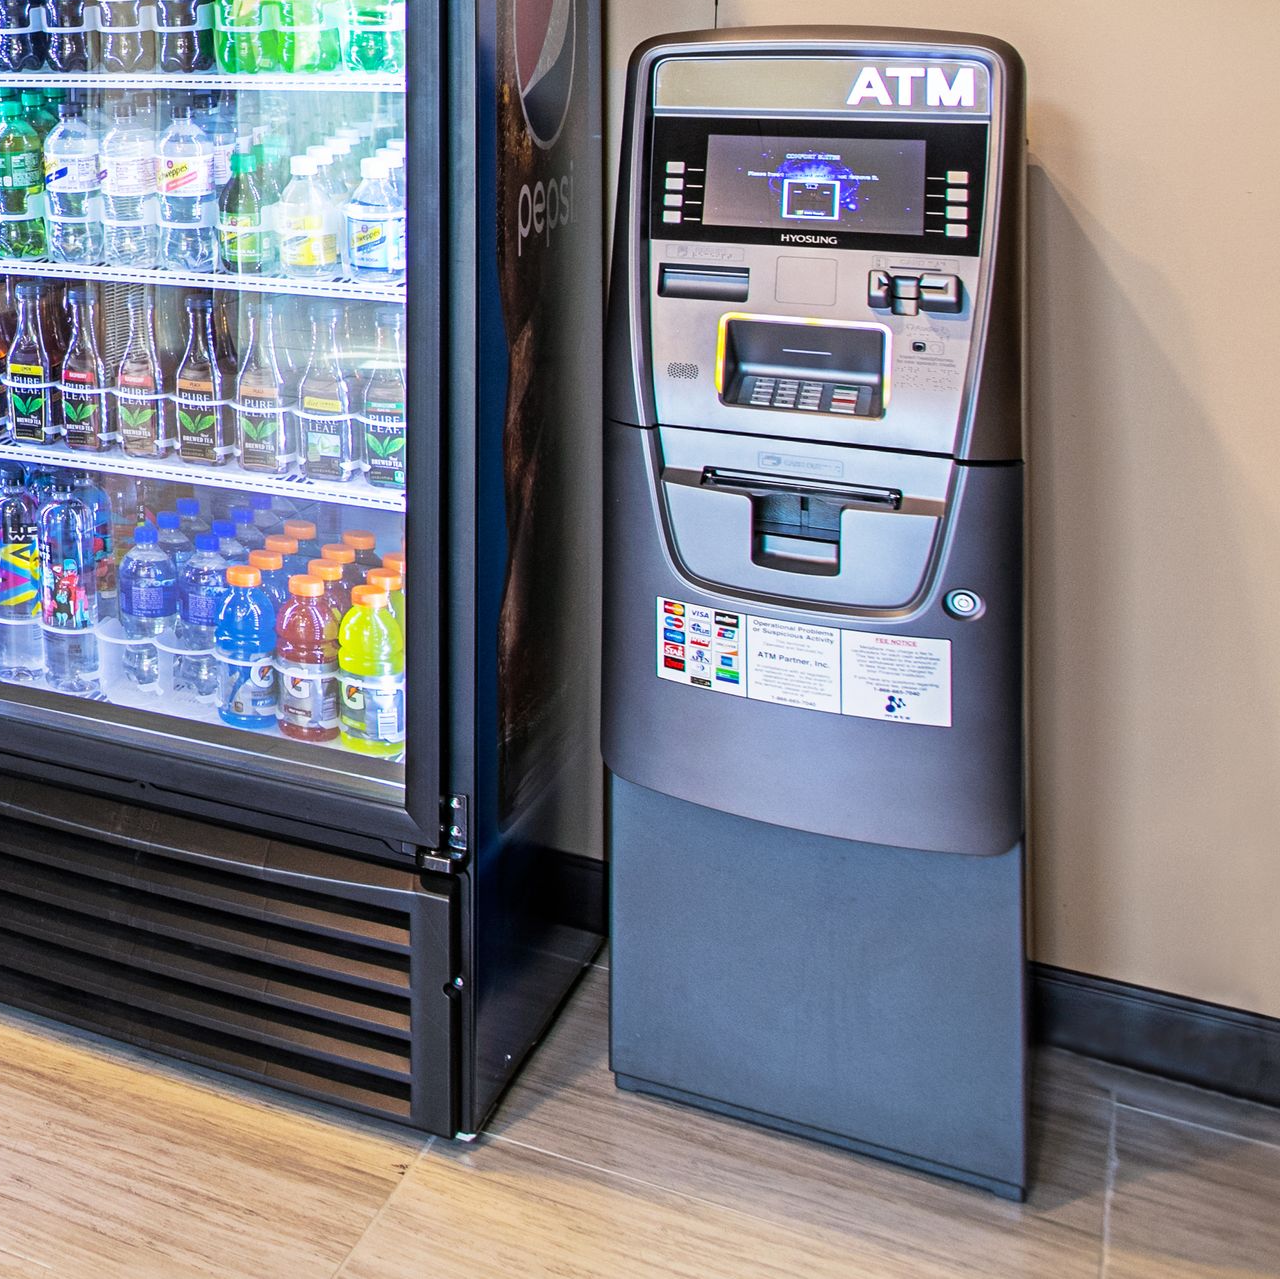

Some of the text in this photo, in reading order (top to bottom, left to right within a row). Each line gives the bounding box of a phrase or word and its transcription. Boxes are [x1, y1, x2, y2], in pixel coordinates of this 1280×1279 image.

[847, 67, 974, 107] ATM
[518, 160, 574, 257] pepsi
[781, 233, 838, 245] HYOSUNG
[13, 376, 40, 385] PURE
[121, 386, 149, 396] PURE
[181, 392, 210, 402] PURE
[244, 399, 273, 409] PURE
[369, 414, 400, 423] PURE
[142, 429, 151, 437] TEA
[182, 435, 213, 444] BREWED TEA
[266, 444, 275, 452] TEA
[371, 458, 403, 468] BREWED TEA
[9, 526, 38, 534] LIF
[8, 534, 39, 542] WT
[691, 609, 710, 619] VISA
[753, 619, 834, 637] Operational Problems
[762, 628, 804, 640] Suspicious
[806, 635, 834, 645] Activity
[890, 639, 918, 647] NOTICE
[757, 651, 830, 669] ATM Partner, Inc.
